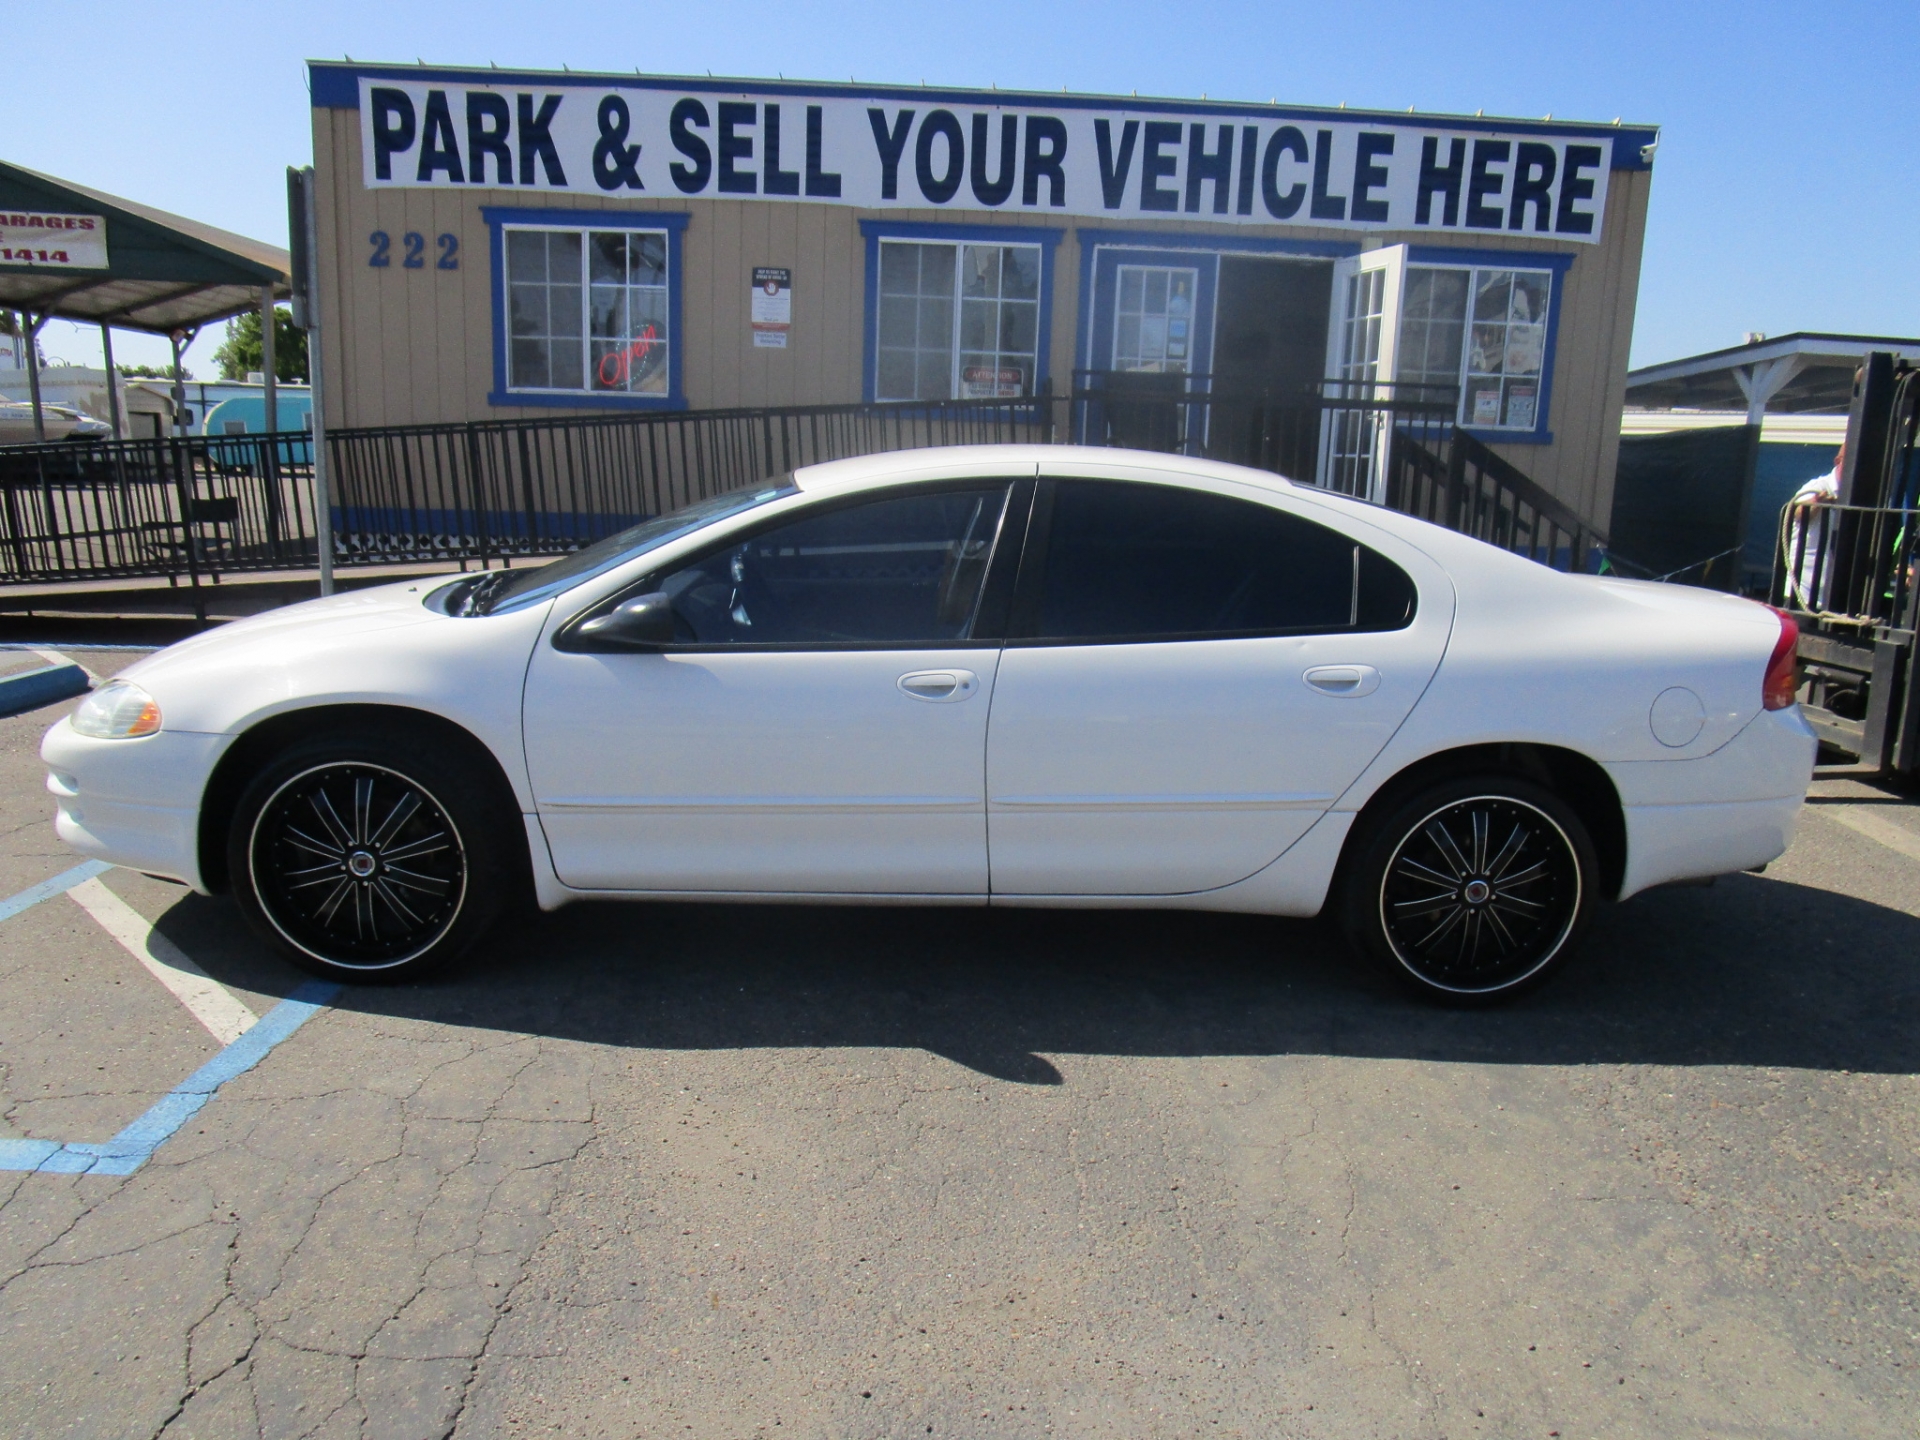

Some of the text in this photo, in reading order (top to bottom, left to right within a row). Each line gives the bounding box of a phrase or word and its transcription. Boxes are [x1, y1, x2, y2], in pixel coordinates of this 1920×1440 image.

[371, 87, 1601, 234] PARK & SELL YOUR VEHICLE HERE
[599, 324, 659, 385] Open
[971, 370, 1013, 380] ATTENION
